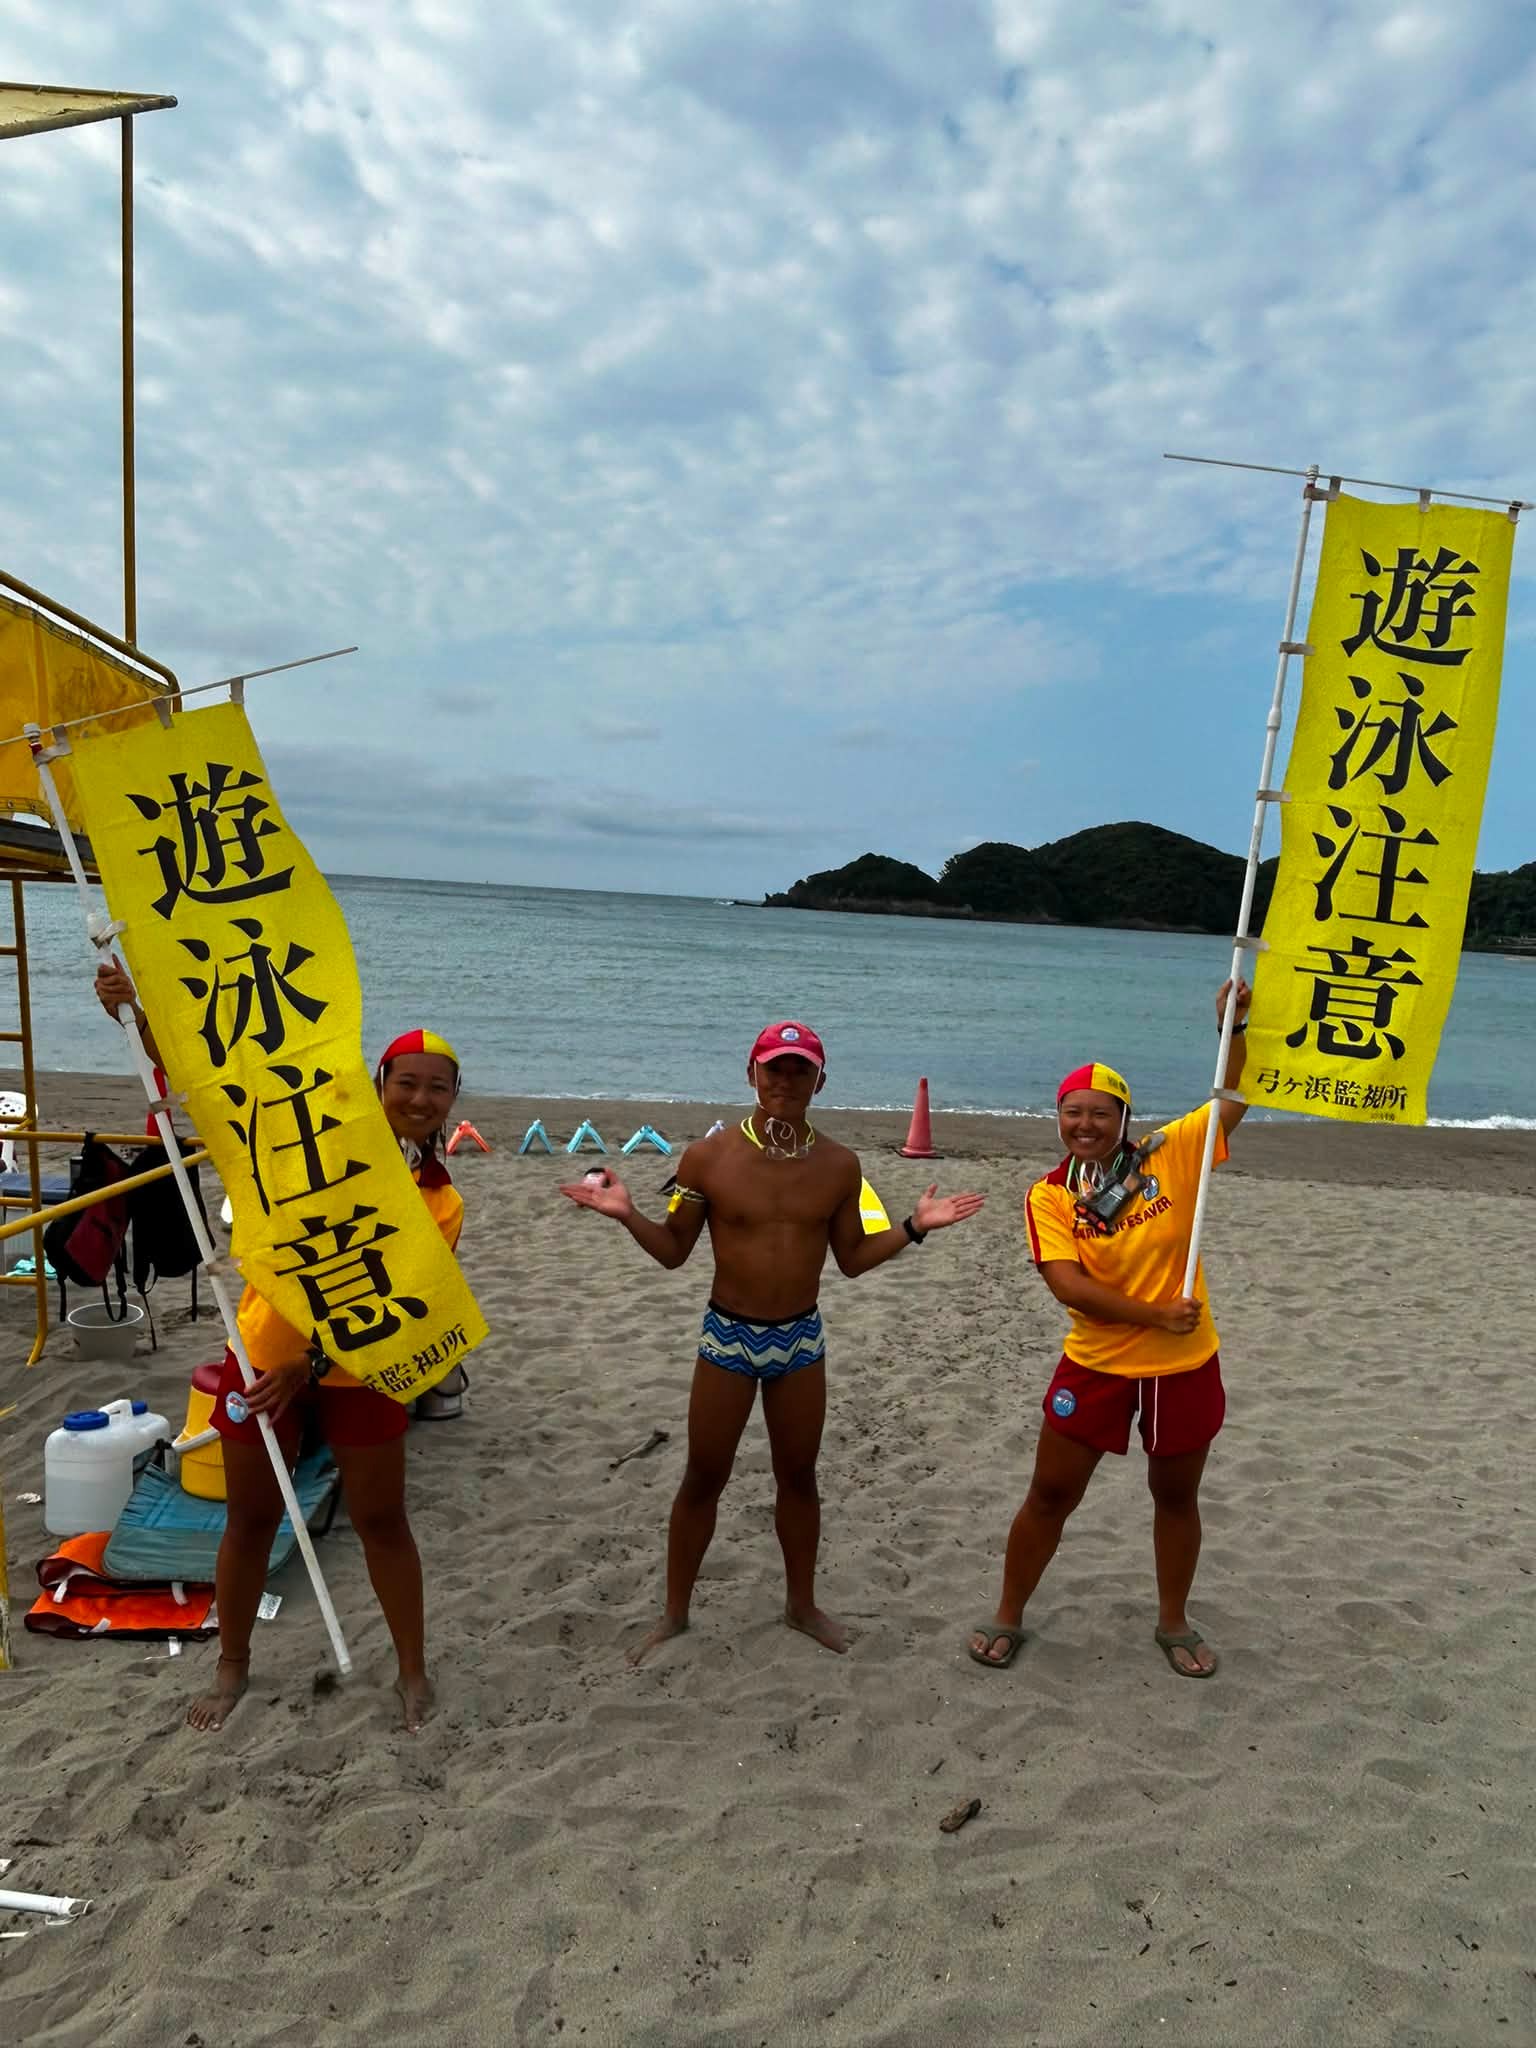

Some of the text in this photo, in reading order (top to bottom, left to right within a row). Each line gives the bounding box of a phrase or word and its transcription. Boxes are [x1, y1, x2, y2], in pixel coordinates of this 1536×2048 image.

[126, 763, 429, 1352] 遊泳注意
[1286, 546, 1481, 1061] 遊泳注意
[1112, 1196, 1172, 1233] IFESAVER
